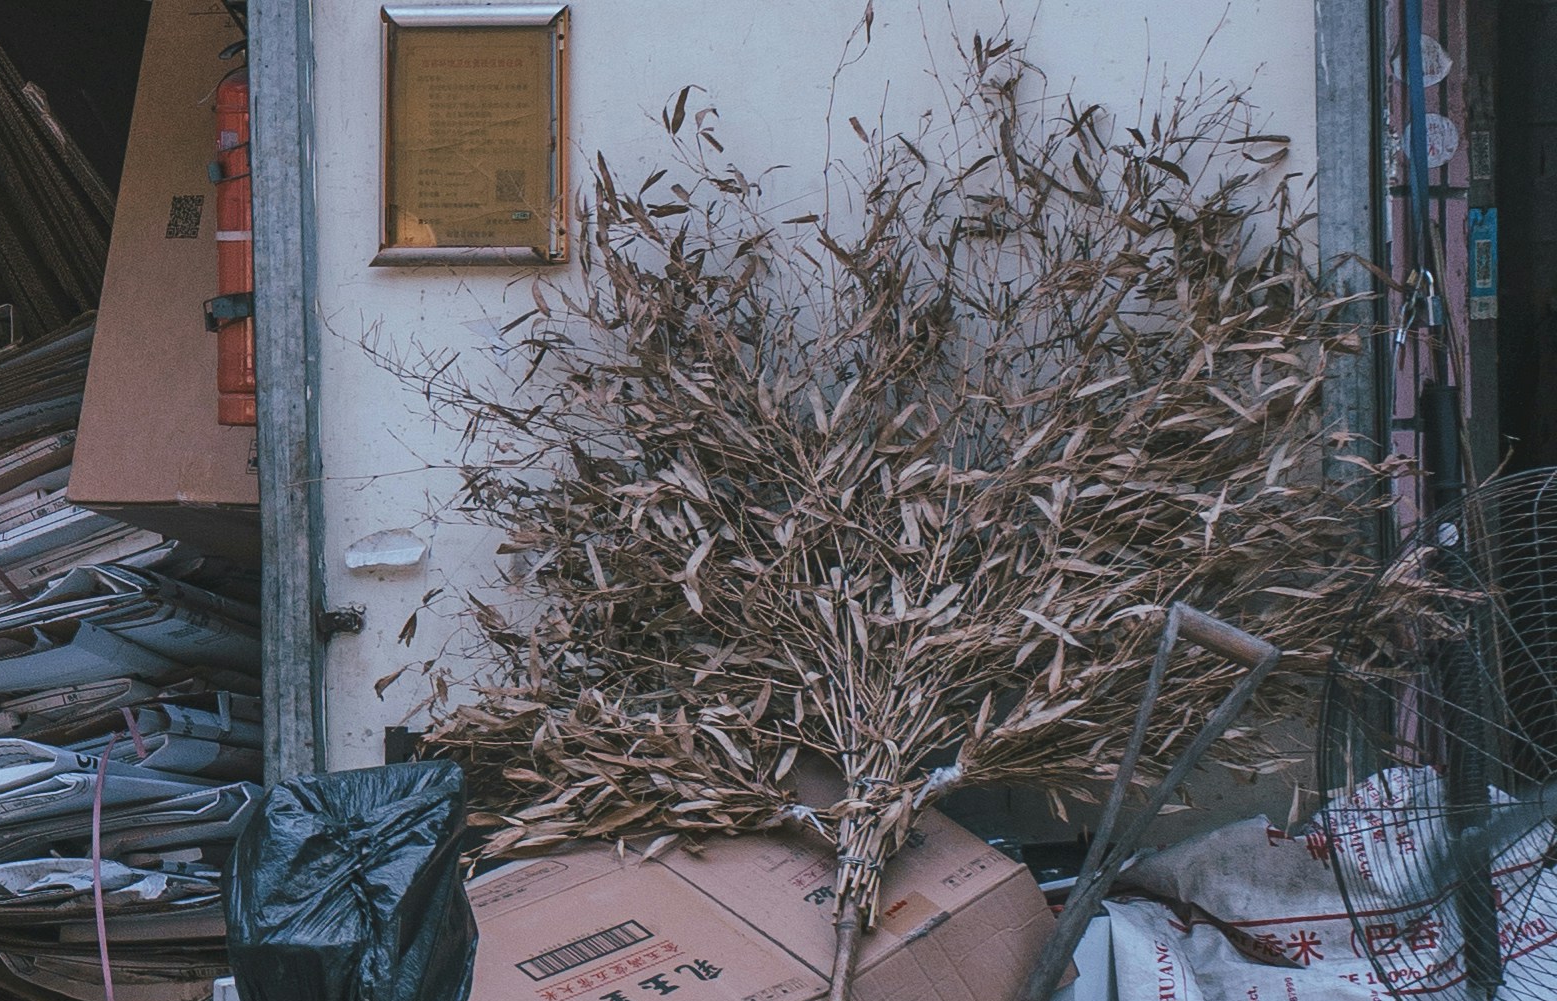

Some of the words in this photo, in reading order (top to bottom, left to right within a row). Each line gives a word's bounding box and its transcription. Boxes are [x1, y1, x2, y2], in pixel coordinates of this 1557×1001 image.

[540, 942, 680, 1001] 金玉满堂五常大米
